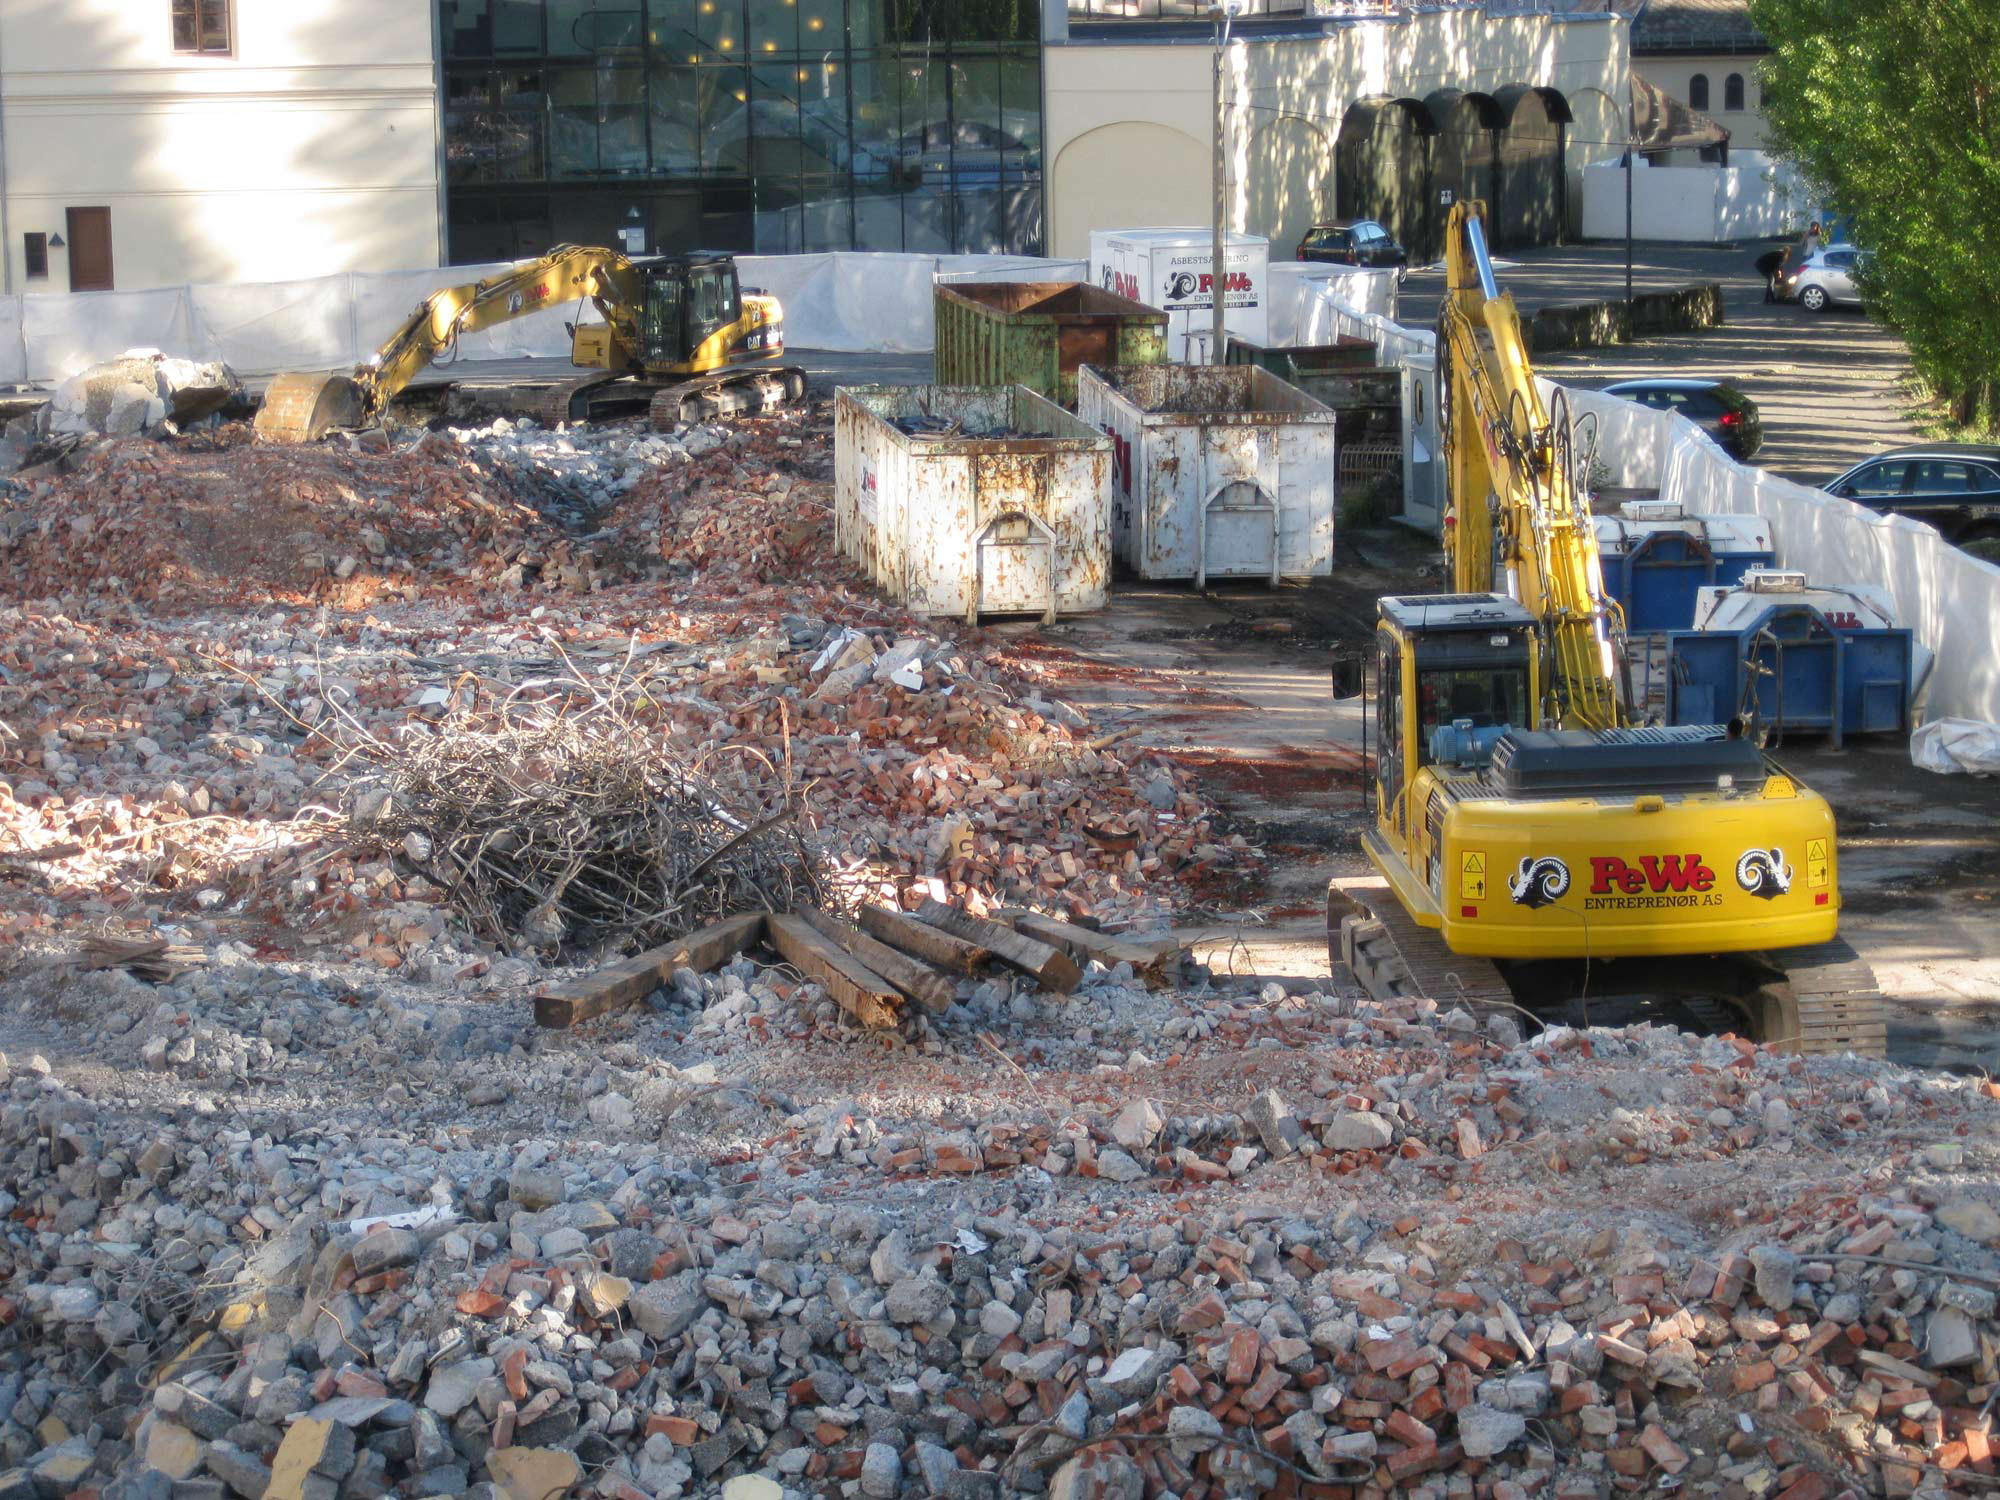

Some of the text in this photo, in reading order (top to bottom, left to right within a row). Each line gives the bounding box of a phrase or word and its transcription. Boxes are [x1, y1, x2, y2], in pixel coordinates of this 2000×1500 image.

[1199, 271, 1253, 293] PWe
[747, 335, 761, 350] CAT
[1590, 854, 1716, 894] PeWe
[1584, 894, 1723, 909] ENTREPRENØR AS
